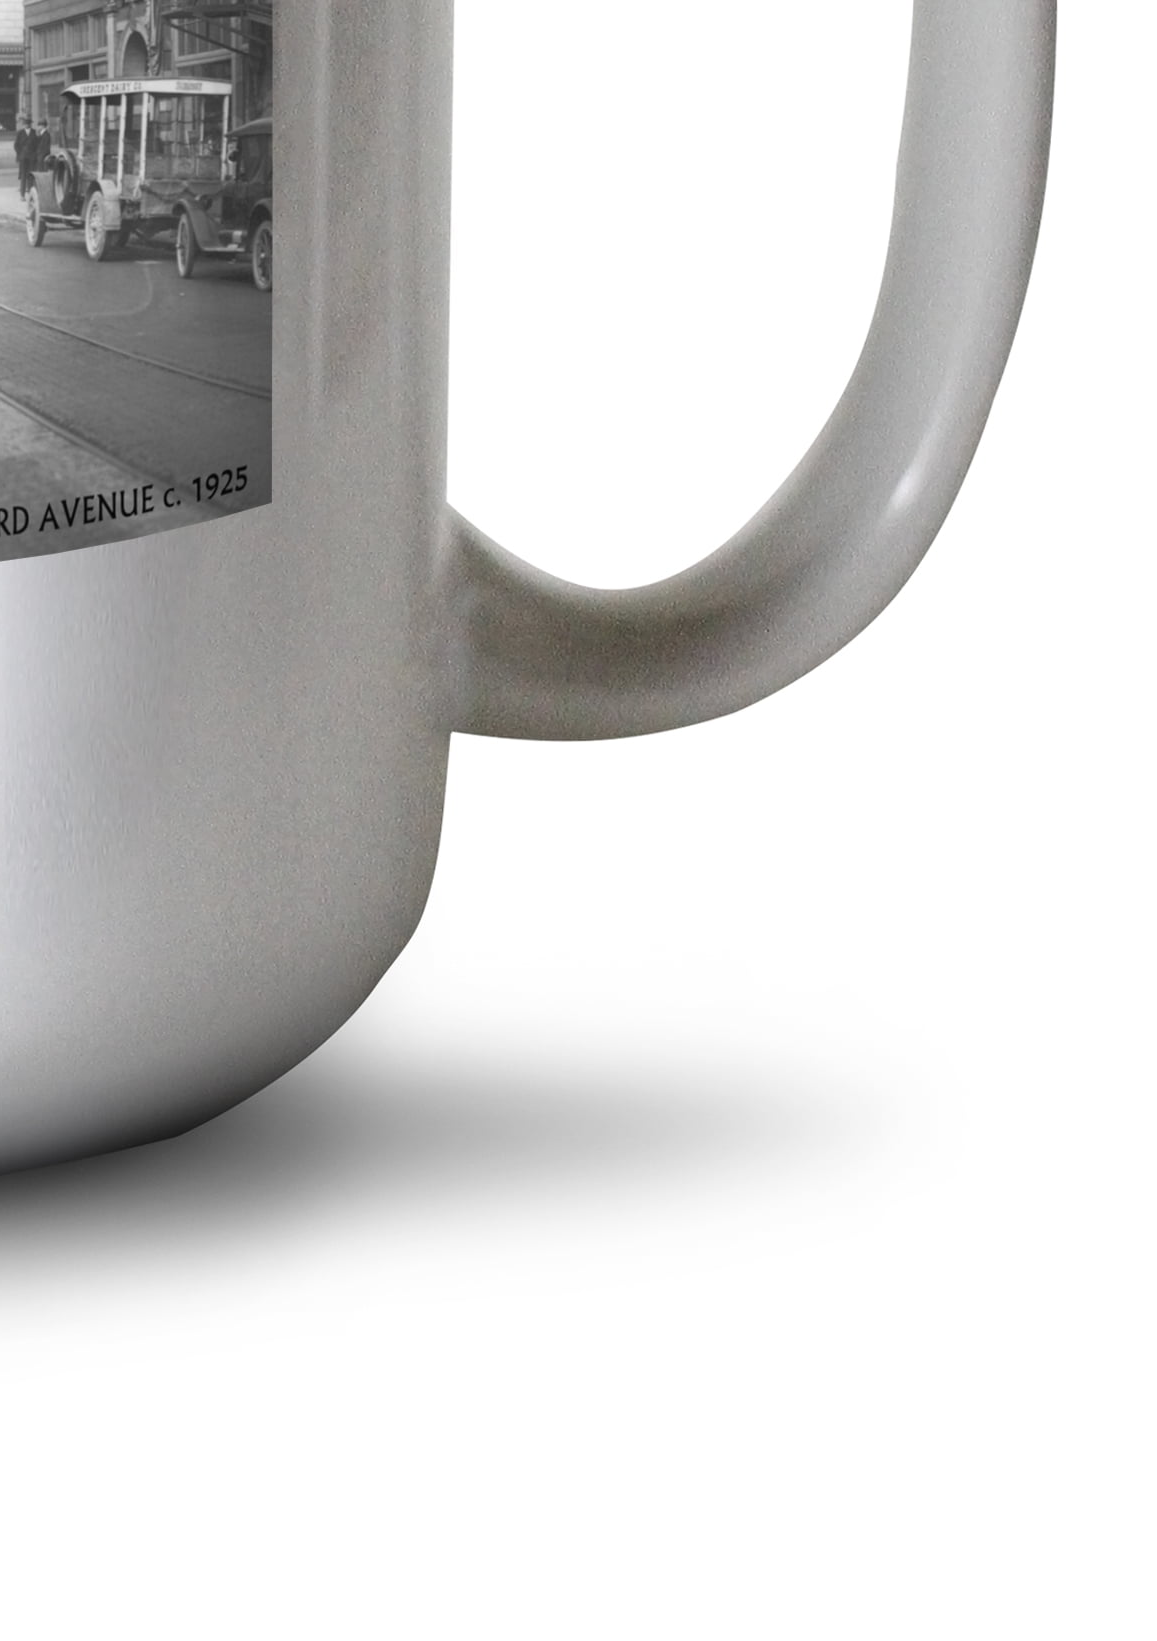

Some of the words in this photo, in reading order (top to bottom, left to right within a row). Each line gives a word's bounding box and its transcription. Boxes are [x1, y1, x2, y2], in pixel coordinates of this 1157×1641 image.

[38, 484, 154, 532] AVENUE
[163, 487, 181, 509] c.
[192, 465, 248, 502] 1925
